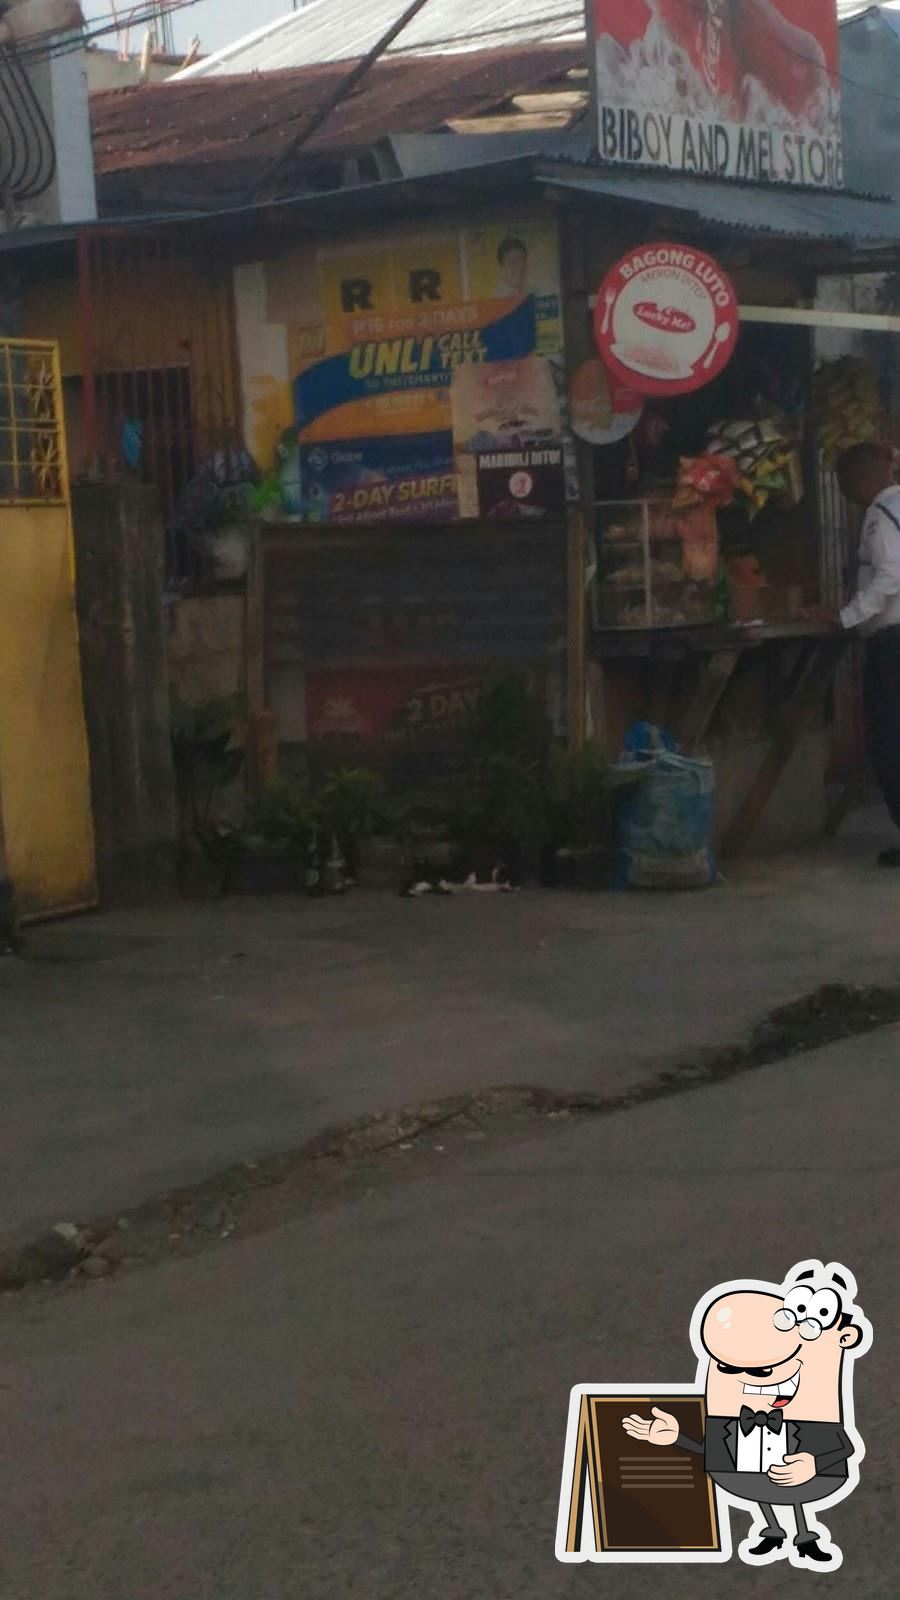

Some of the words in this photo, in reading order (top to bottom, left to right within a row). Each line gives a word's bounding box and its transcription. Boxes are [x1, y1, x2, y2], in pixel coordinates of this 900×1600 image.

[601, 107, 672, 165] BIBOY
[681, 119, 730, 172] AND
[736, 127, 777, 178] MEL
[341, 277, 374, 312] R
[409, 269, 441, 302] R
[619, 249, 696, 279] BAGONG
[695, 261, 730, 307] LUTO
[635, 306, 672, 326] Lucky
[349, 334, 434, 379] UNLI
[437, 329, 481, 351] CALL
[440, 346, 487, 369] TEXT
[333, 482, 396, 513] 2-DAY
